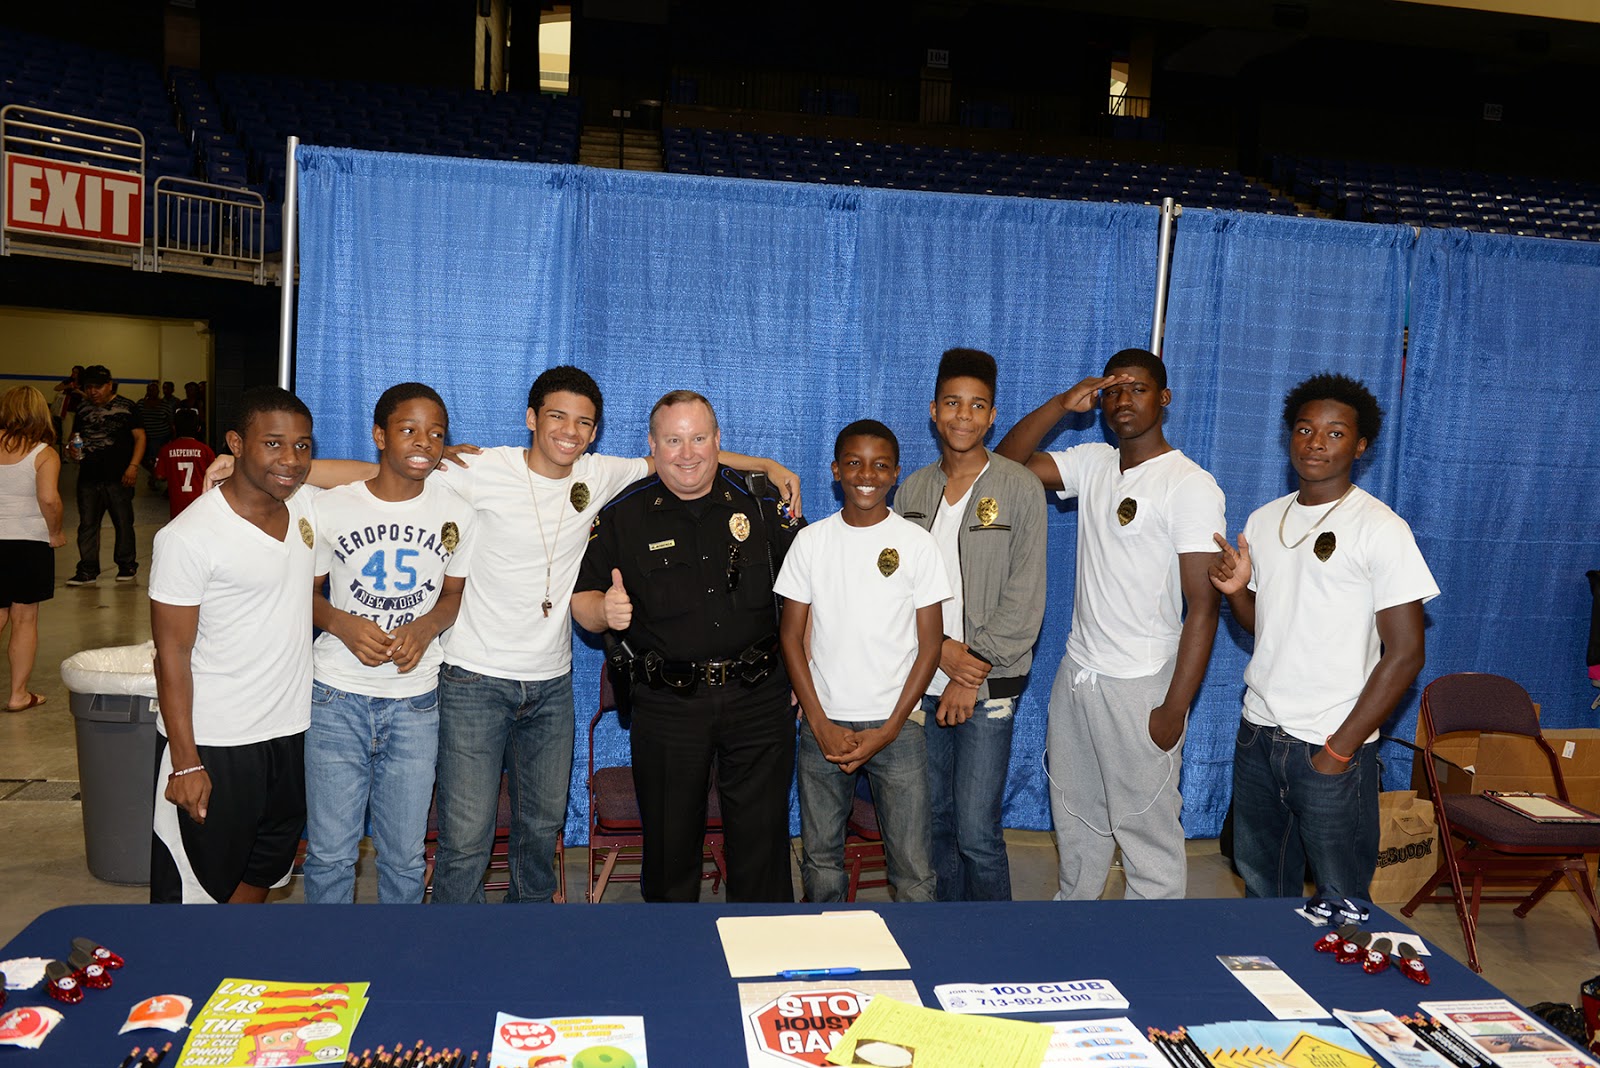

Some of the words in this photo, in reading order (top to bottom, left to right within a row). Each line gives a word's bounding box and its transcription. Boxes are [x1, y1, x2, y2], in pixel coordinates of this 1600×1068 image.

[930, 51, 947, 63] 104
[12, 162, 139, 236] EXIT
[169, 449, 201, 458] KAEPERNICK
[177, 462, 194, 492] 7
[361, 548, 419, 591] 45
[359, 591, 387, 609] NEW
[392, 590, 424, 610] YORK
[217, 982, 268, 997] LAS
[990, 986, 1031, 996] 100
[1037, 982, 1105, 993] CLUB
[212, 998, 264, 1014] LAS
[976, 994, 1091, 1007] 713-952-0100
[200, 1018, 251, 1032] THE
[504, 1024, 547, 1036] TEX
[191, 1039, 210, 1047] OF
[211, 1039, 240, 1047] CELL
[509, 1035, 551, 1048] DOT
[186, 1047, 236, 1057] PHONE
[182, 1056, 233, 1067] SALLY!
